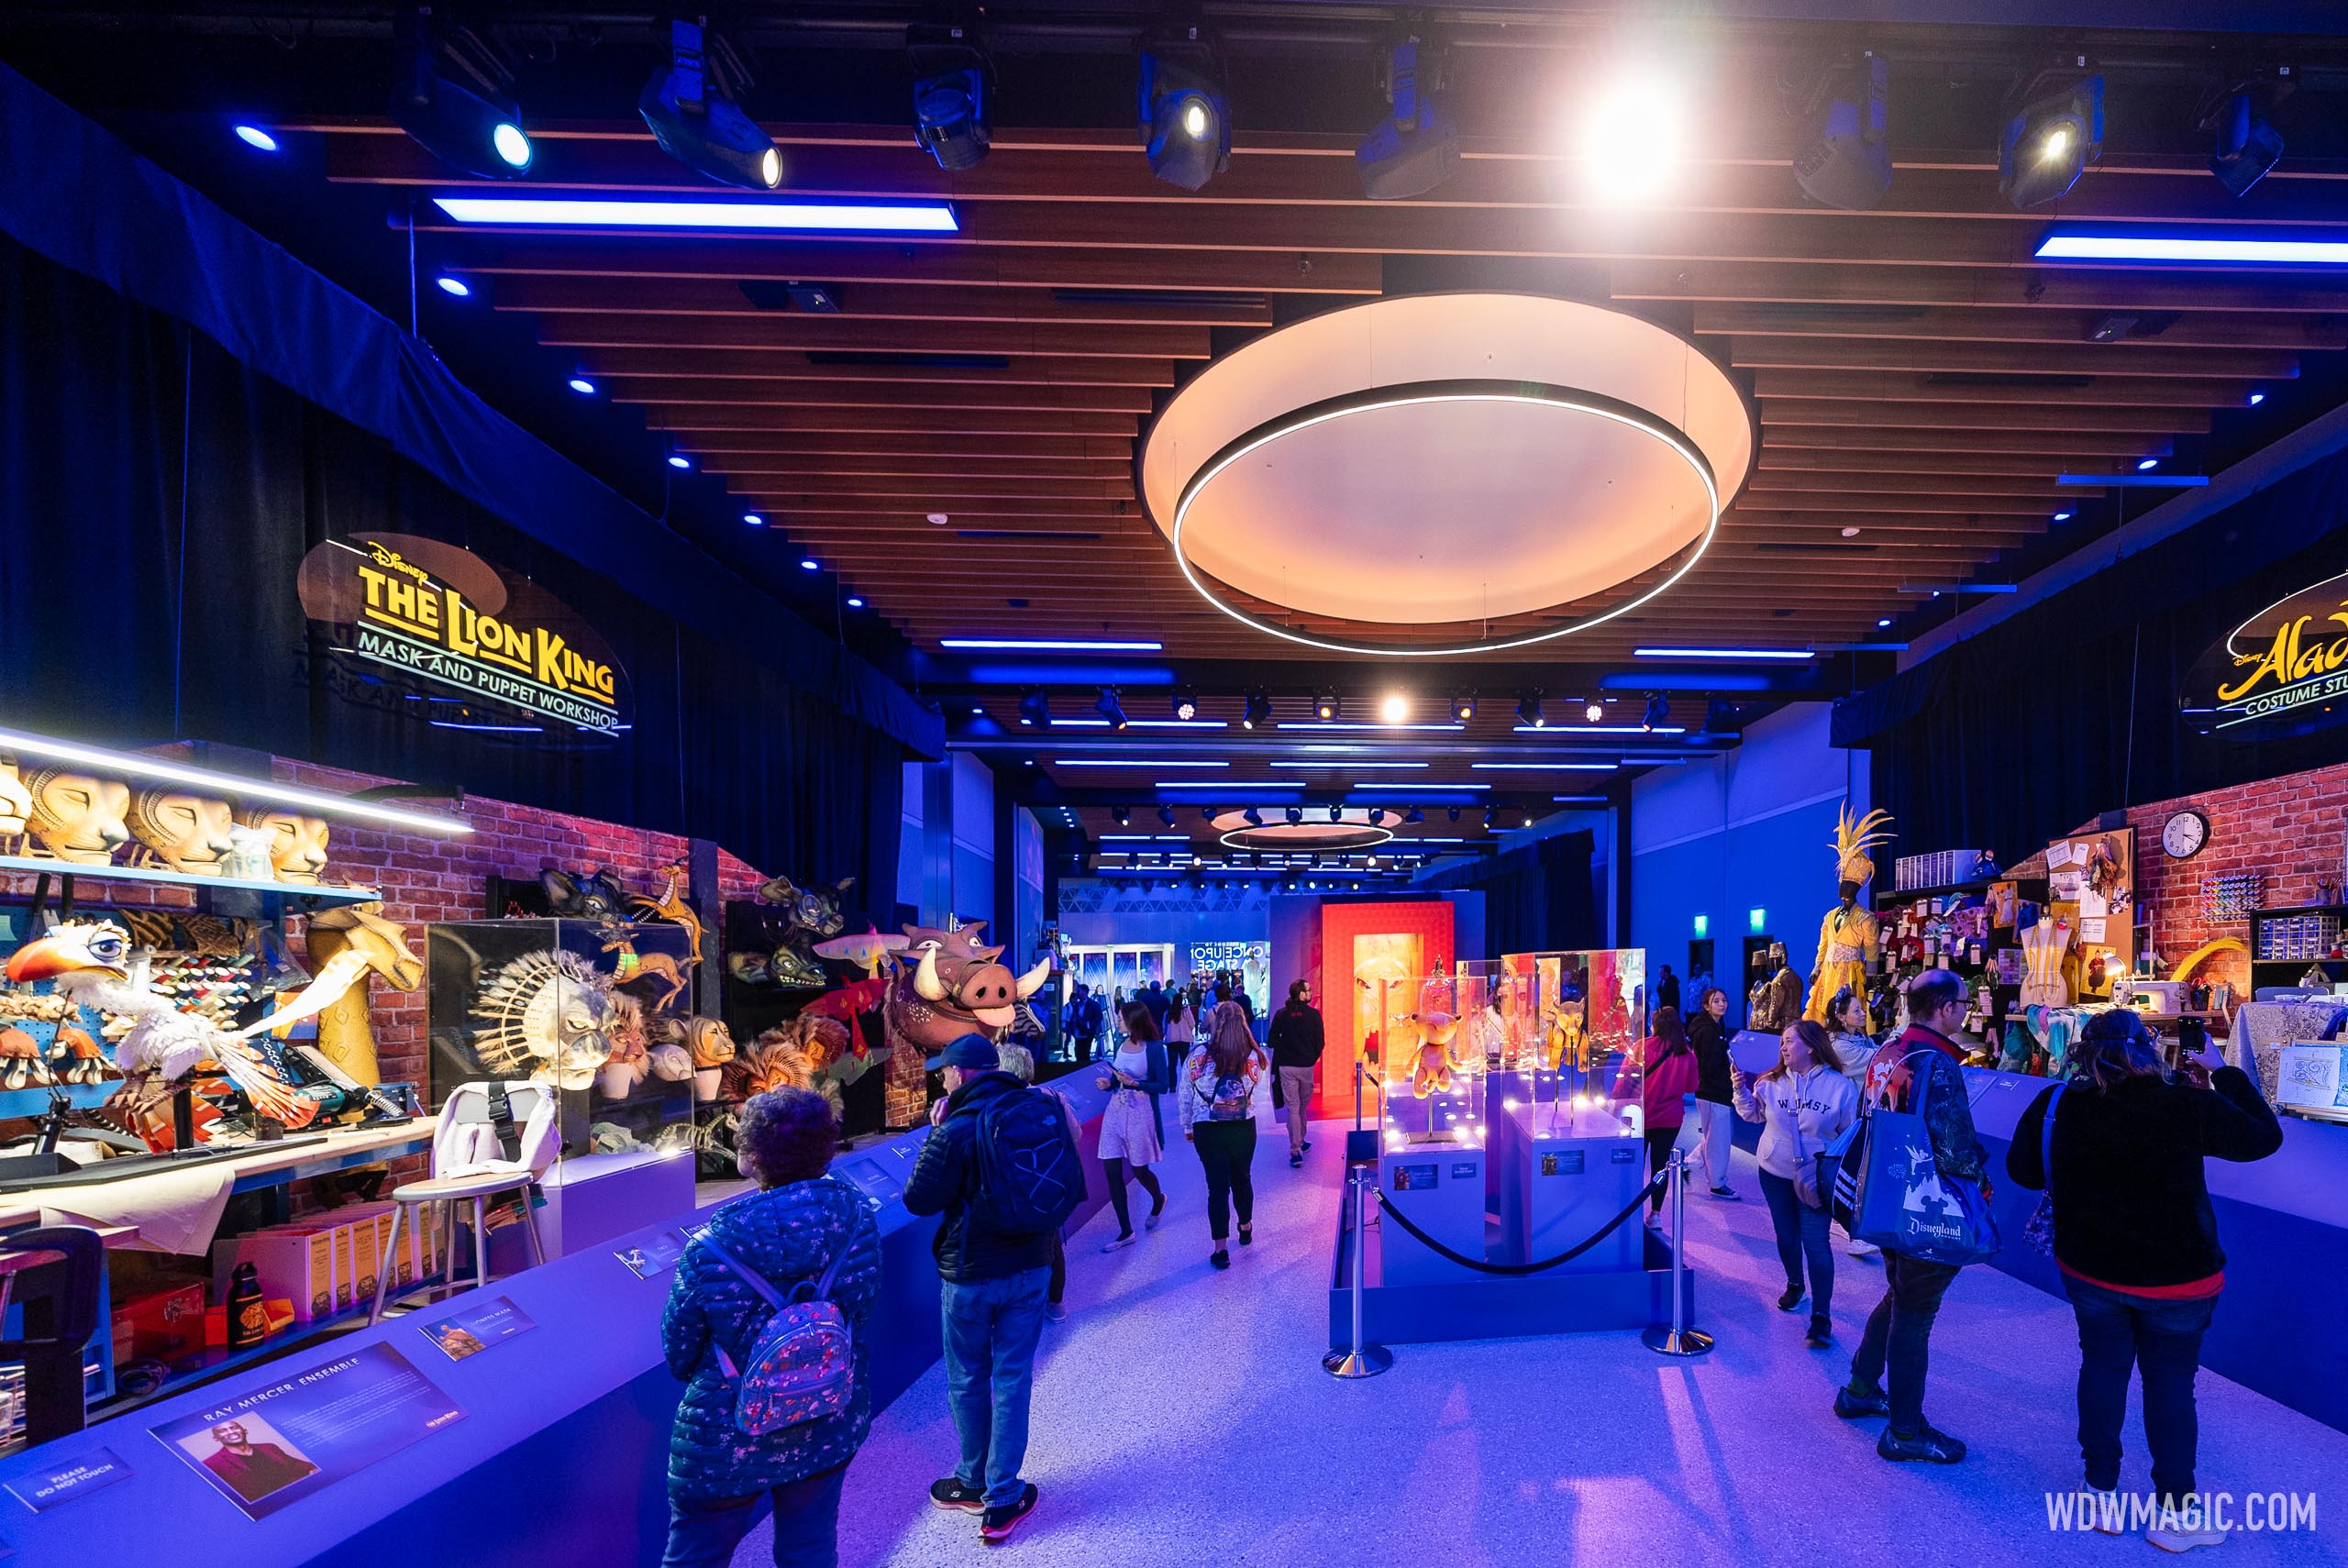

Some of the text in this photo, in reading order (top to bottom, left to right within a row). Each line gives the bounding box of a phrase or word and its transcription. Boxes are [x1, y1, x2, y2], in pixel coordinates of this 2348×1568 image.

[359, 566, 615, 694] THE LION KING
[359, 631, 619, 730] MASK AND PUPPET WORKSHOP
[2245, 683, 2320, 715] COSTUME
[1906, 1216, 1961, 1238] Disneyland
[204, 1406, 233, 1422] RAY
[298, 1357, 360, 1386] ENSEMBLE
[35, 1463, 114, 1497] DO NOT TOUCH
[51, 1466, 88, 1483] PLEASE
